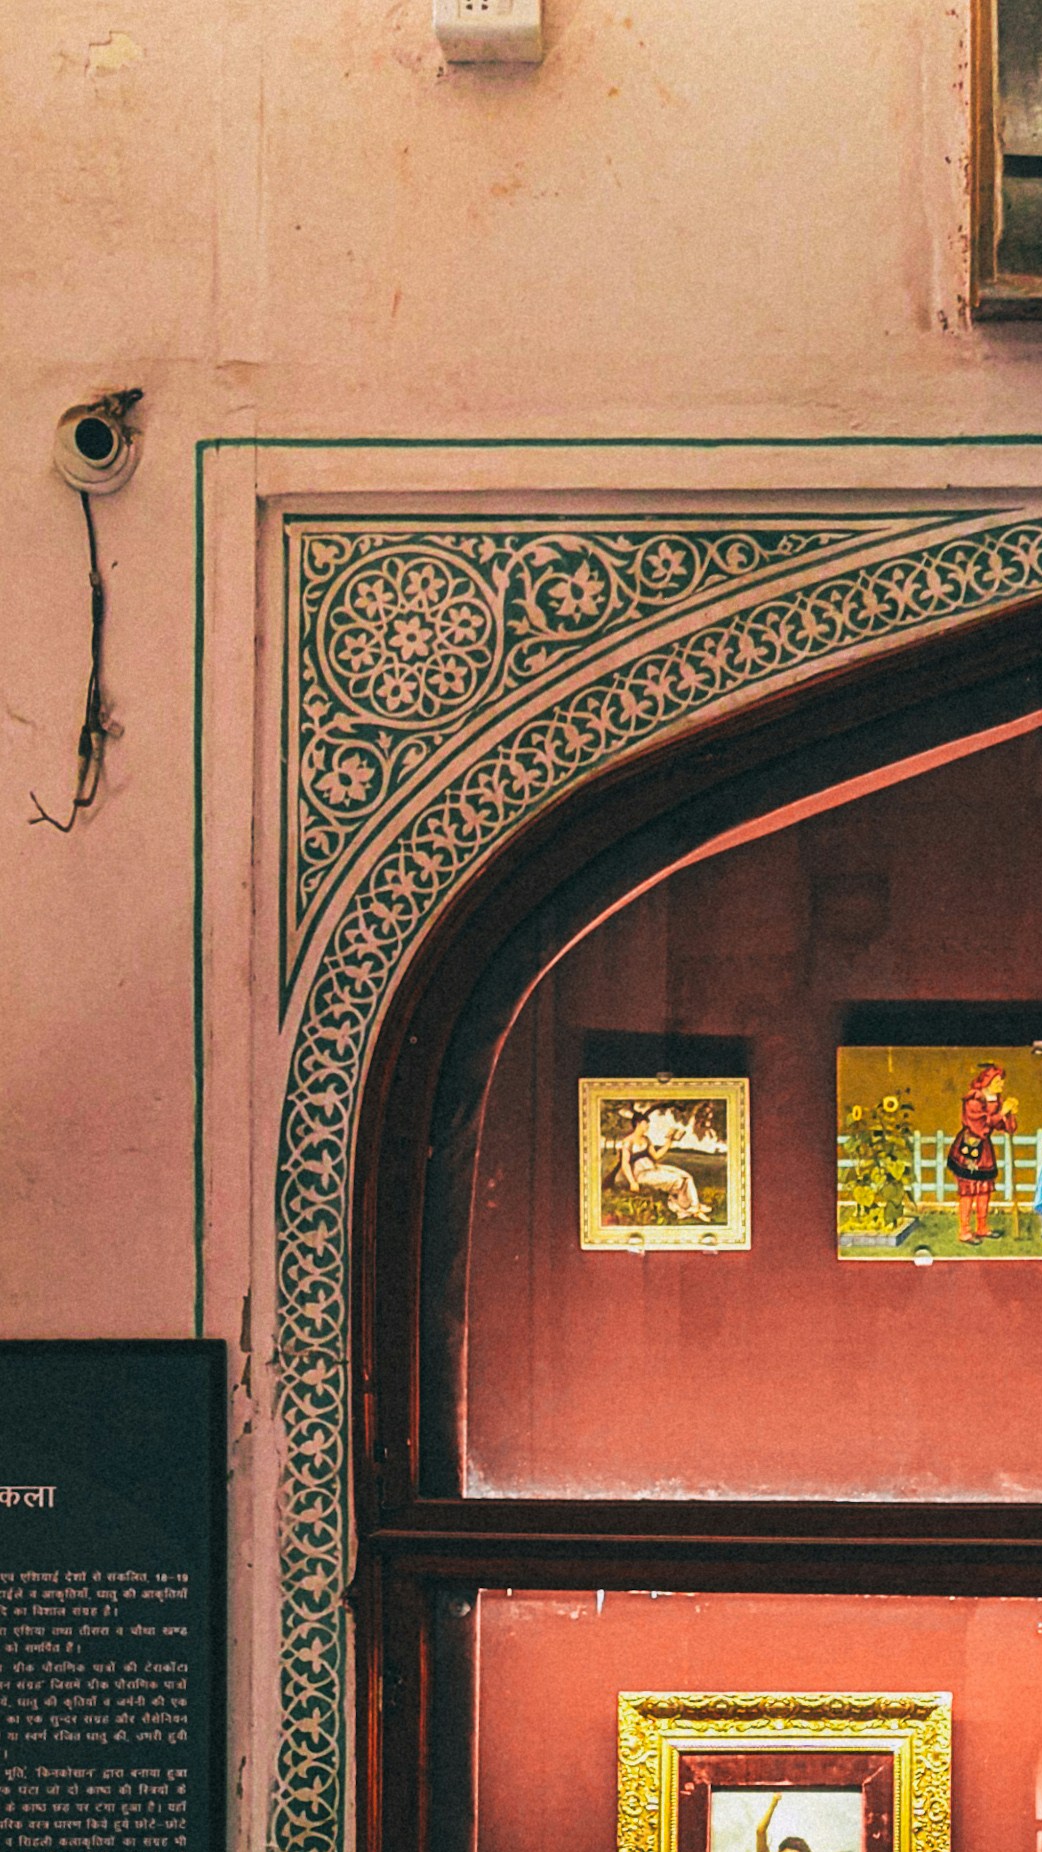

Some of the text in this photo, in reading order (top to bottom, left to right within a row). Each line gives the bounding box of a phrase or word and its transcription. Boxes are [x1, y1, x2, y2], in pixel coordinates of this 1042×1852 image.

[0, 1486, 57, 1508] कला
[122, 1588, 136, 1598] की
[32, 1605, 65, 1615] विशाल
[12, 1661, 34, 1672] ग्रीक
[123, 1661, 137, 1672] की
[43, 1696, 57, 1706] की
[151, 1695, 164, 1706] की
[170, 1698, 187, 1707] एक
[25, 1715, 42, 1725] एक
[49, 1716, 77, 1727] सुन्दर
[115, 1713, 134, 1723] और
[102, 1769, 124, 1779] द्वारा
[166, 1769, 187, 1781] हुआ
[118, 1784, 131, 1794] की
[121, 1804, 141, 1815] हुआ
[122, 1838, 135, 1846] का
